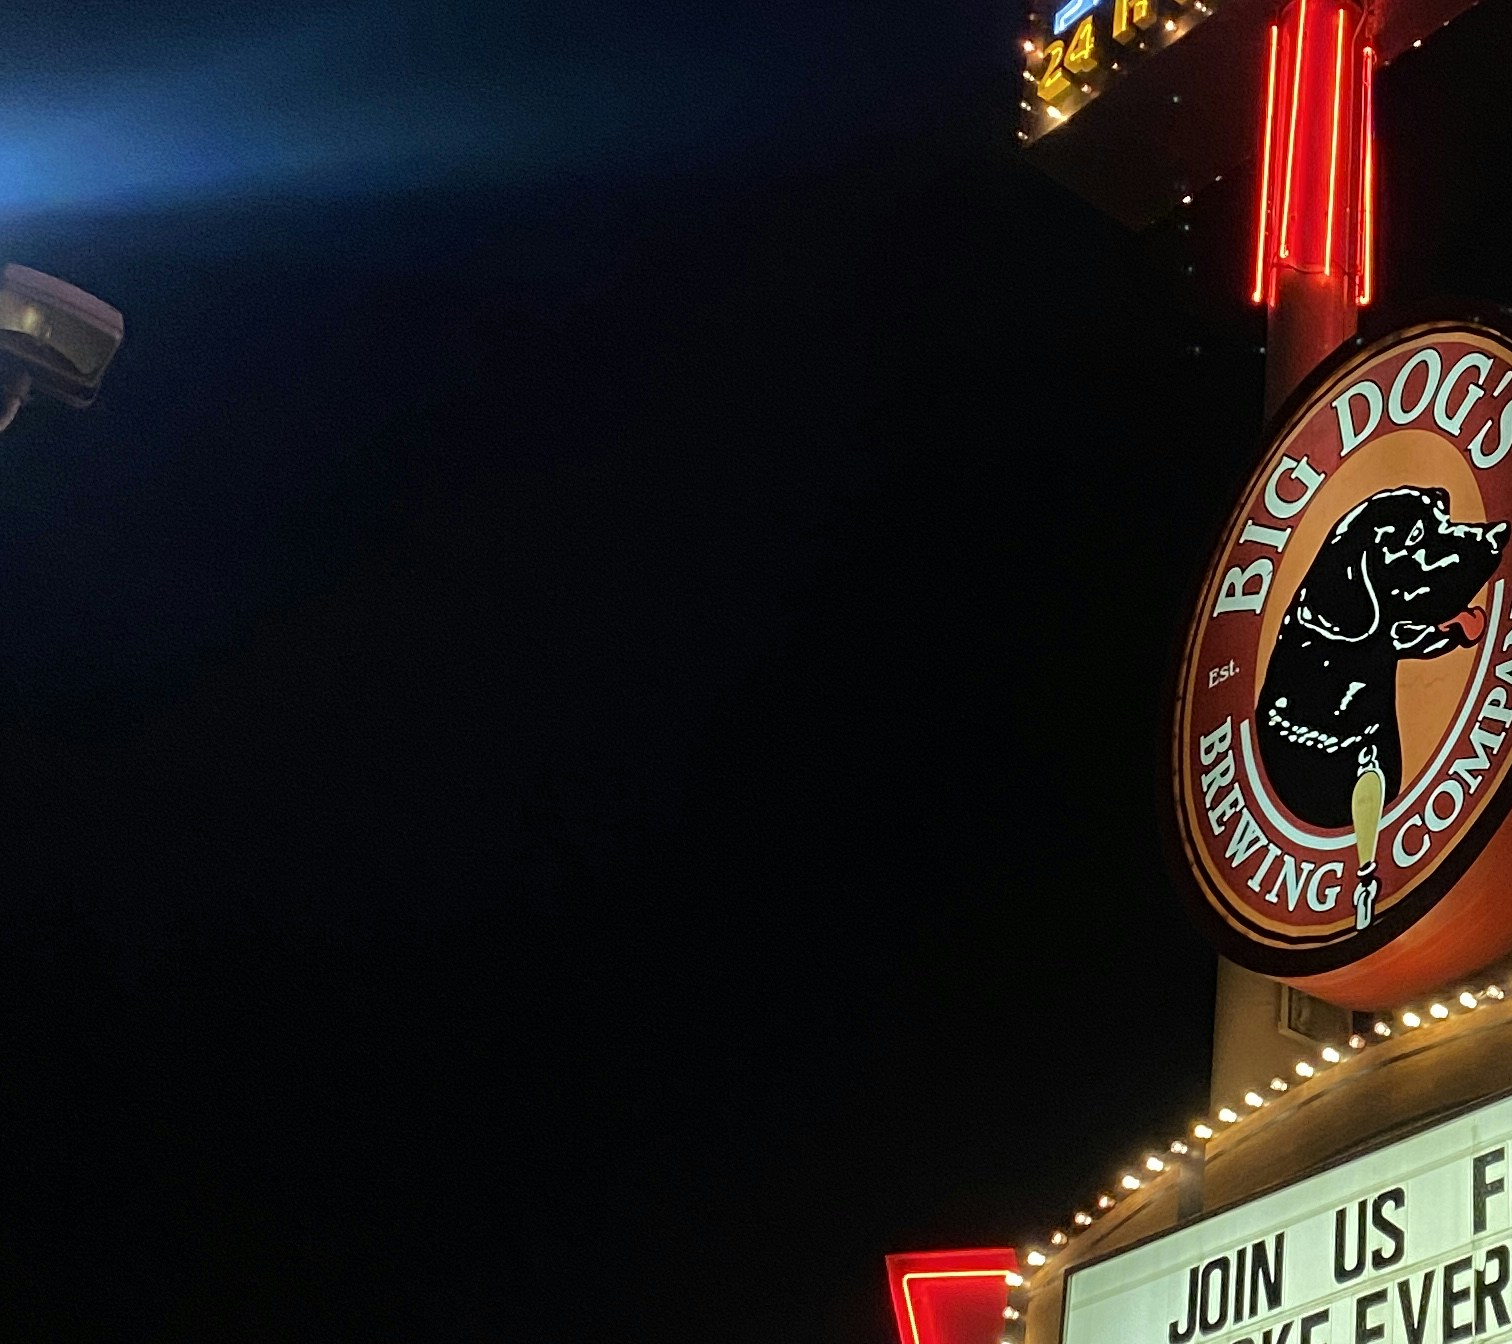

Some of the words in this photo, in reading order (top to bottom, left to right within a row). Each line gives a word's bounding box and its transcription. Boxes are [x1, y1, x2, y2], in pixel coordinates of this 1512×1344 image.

[1037, 15, 1097, 101] 24
[1212, 452, 1326, 620] BIG
[1208, 658, 1240, 689] Est.
[1200, 715, 1342, 913] BREWING
[1333, 1186, 1406, 1284] US
